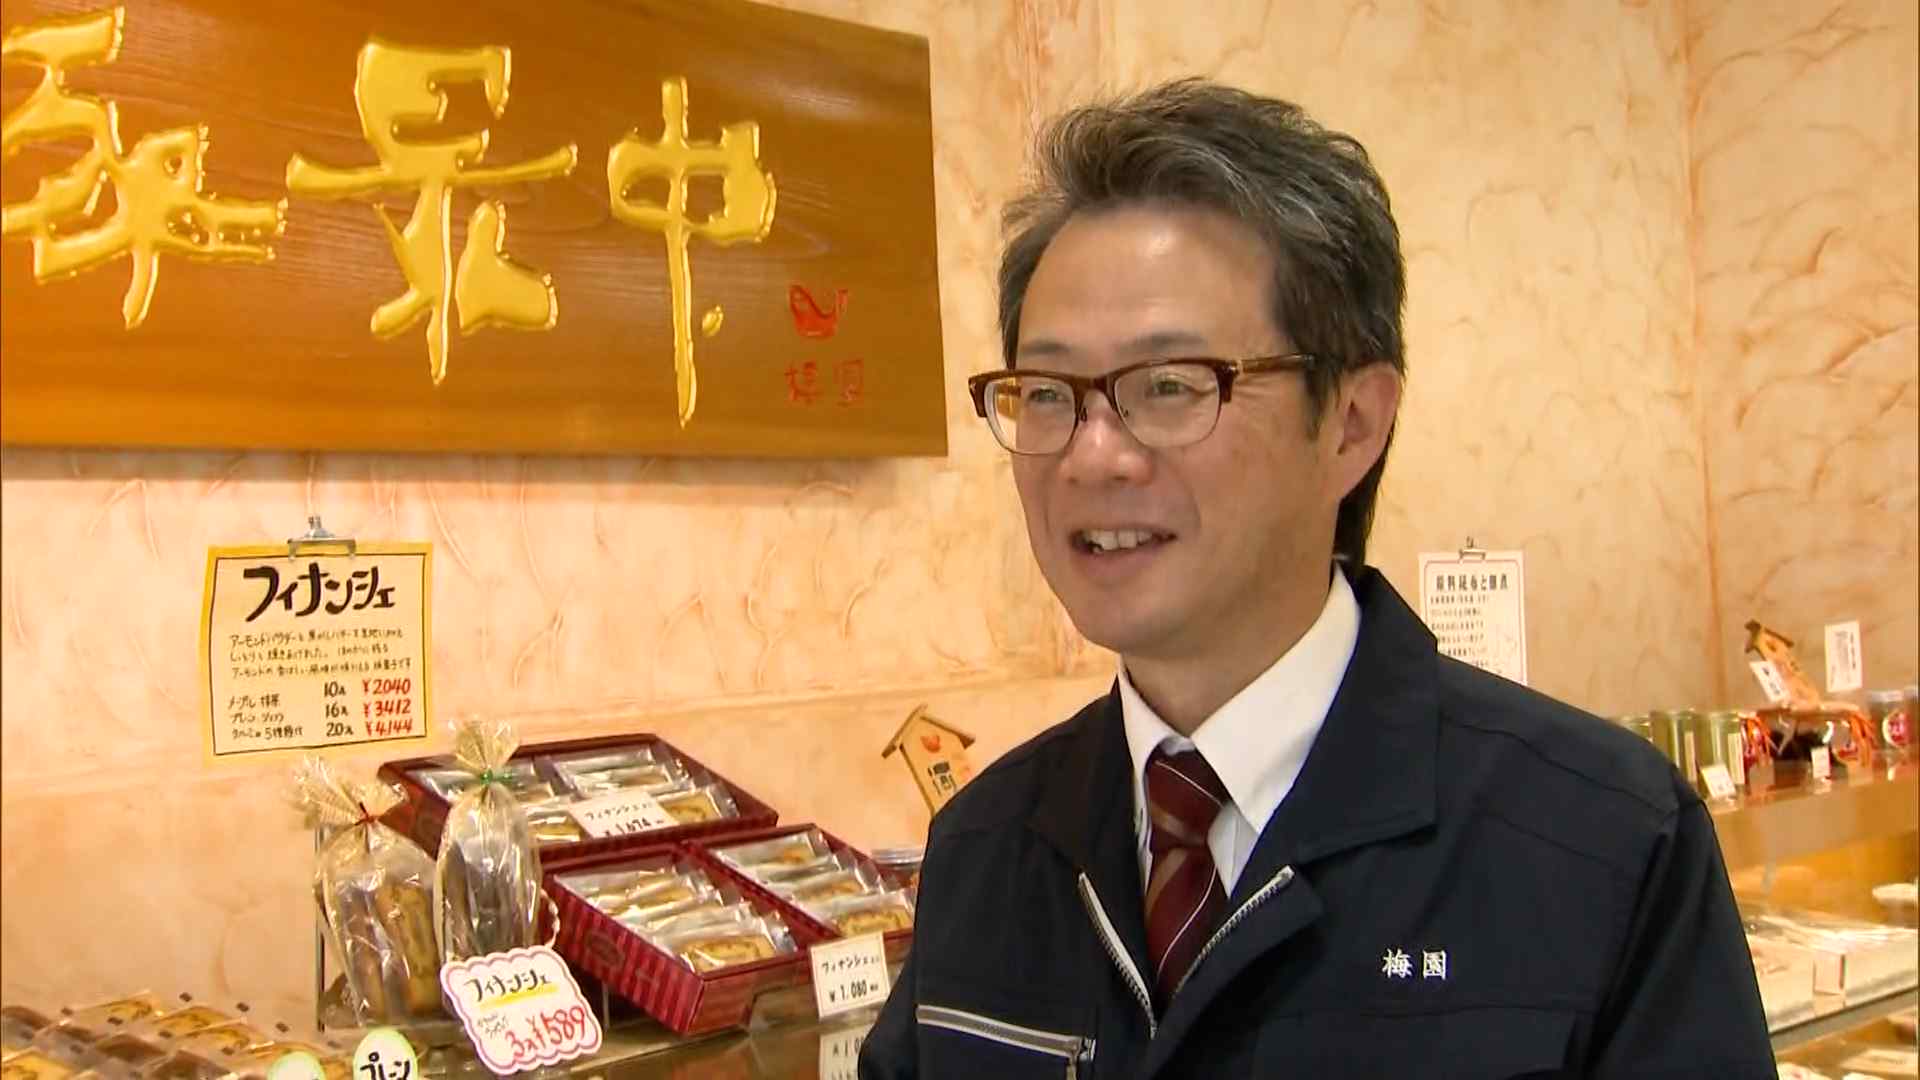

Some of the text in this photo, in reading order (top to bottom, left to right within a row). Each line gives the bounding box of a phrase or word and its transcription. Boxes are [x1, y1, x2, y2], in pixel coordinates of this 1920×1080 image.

[243, 562, 396, 622] フィナンシェ
[1381, 948, 1447, 980] 梅園
[463, 969, 552, 1003] フィナンシェ
